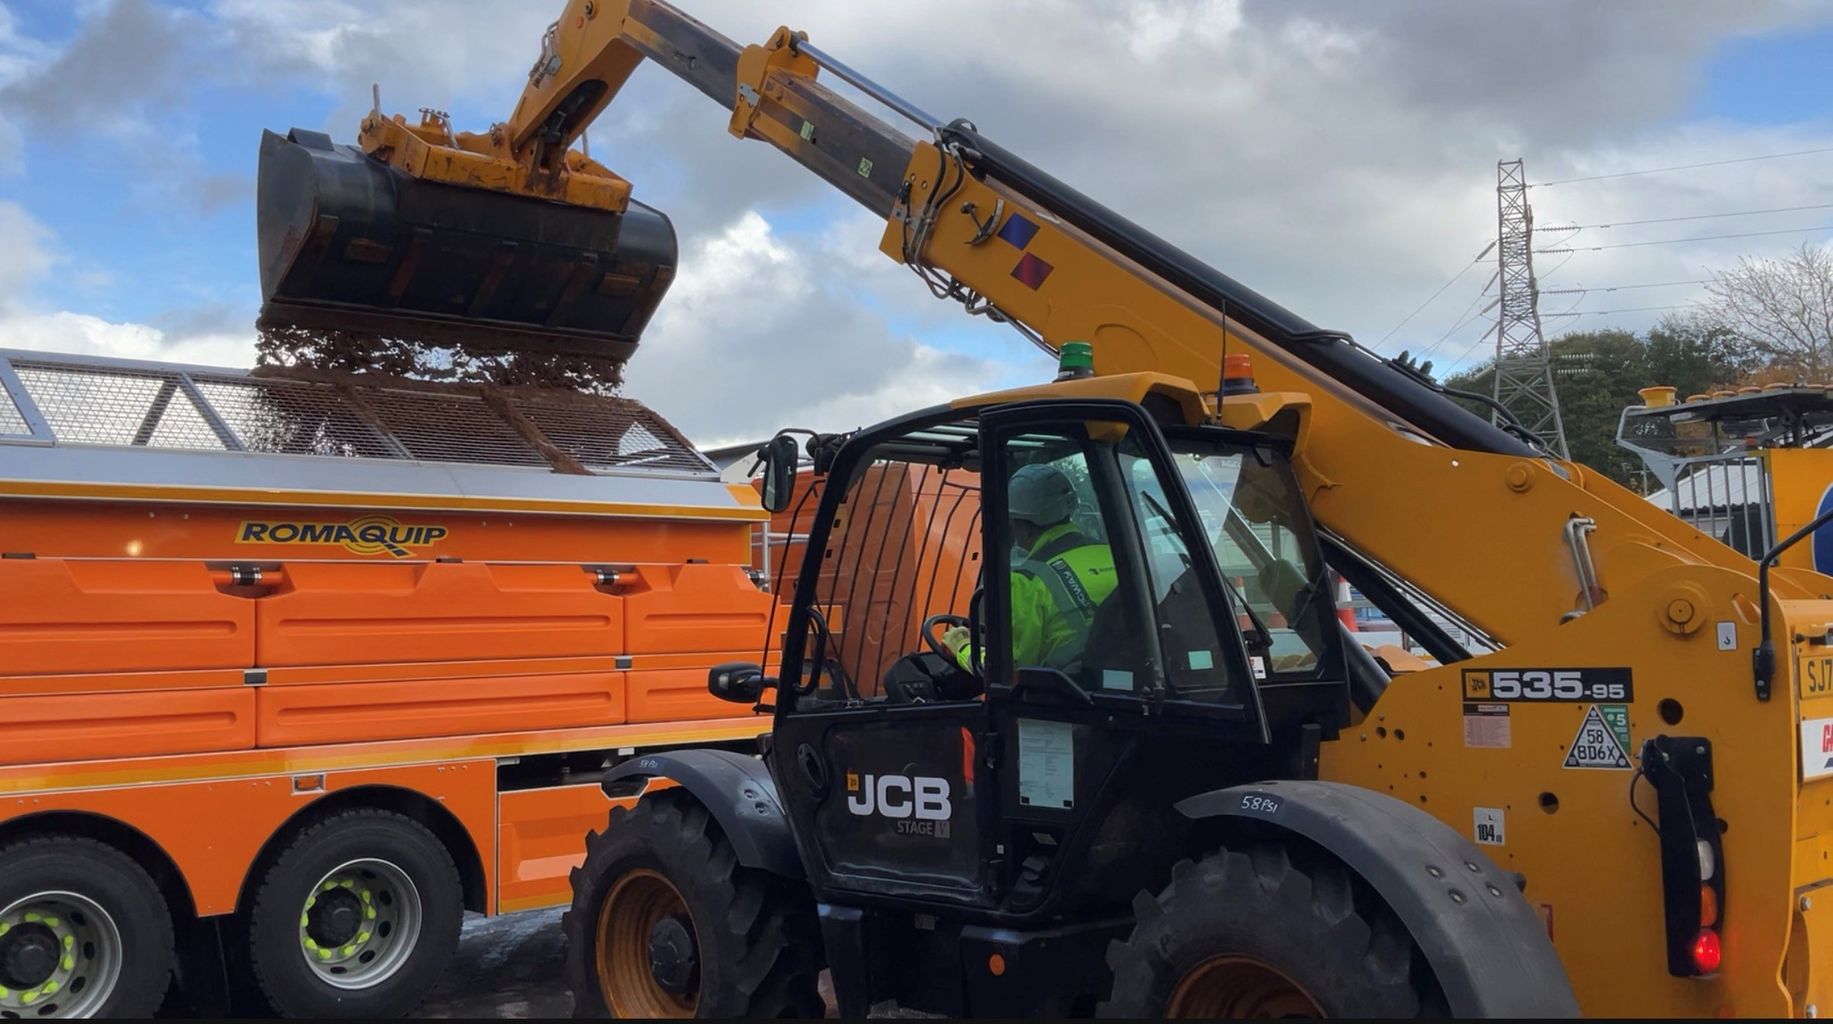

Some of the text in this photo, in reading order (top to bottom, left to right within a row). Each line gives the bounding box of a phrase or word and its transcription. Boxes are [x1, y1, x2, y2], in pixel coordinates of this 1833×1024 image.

[242, 522, 447, 557] ROMAQUIP
[1493, 671, 1625, 698] 535-95
[1616, 713, 1626, 726] 5
[1587, 729, 1604, 744] 58
[1577, 745, 1616, 761] BD6X
[848, 774, 952, 821] JCB
[897, 821, 934, 836] STAGE
[1477, 823, 1495, 842] 104
